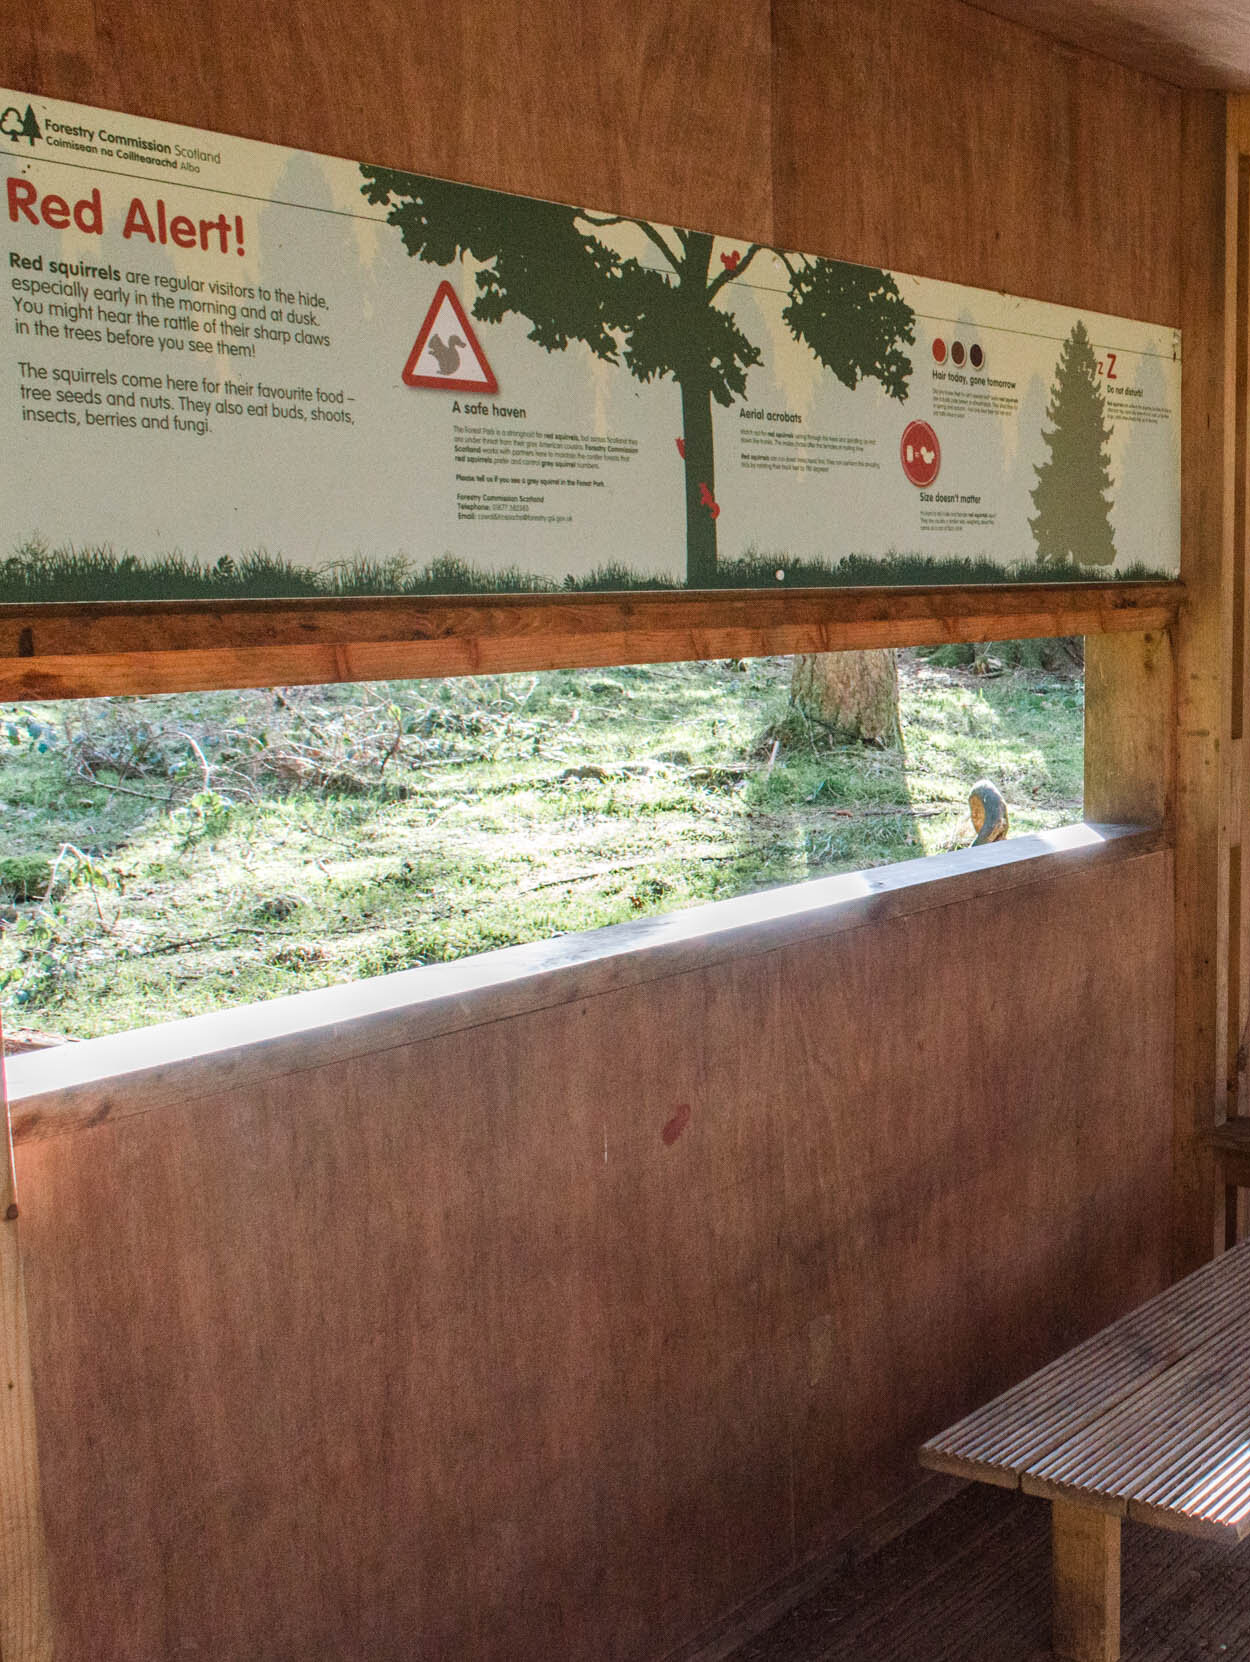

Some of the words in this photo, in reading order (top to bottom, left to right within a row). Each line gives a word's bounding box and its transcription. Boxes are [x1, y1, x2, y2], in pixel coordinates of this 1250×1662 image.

[45, 118, 95, 141] Forestry
[98, 129, 172, 154] Commission
[174, 145, 221, 164] Scotland
[100, 148, 113, 157] na
[180, 162, 201, 174] Alba
[6, 177, 103, 235] Red
[123, 198, 245, 257] Alert!
[9, 251, 43, 272] Red
[49, 261, 121, 281] squirrels
[125, 271, 150, 285] are
[154, 275, 205, 293] regular
[208, 280, 255, 299] visitors
[258, 286, 272, 301] to
[274, 288, 295, 304] the
[299, 290, 330, 310] hide,
[11, 277, 89, 302] especially
[93, 286, 130, 306] early
[134, 289, 148, 305] in
[151, 291, 175, 309] the
[178, 298, 237, 320] morning
[240, 305, 266, 320] and
[270, 309, 283, 322] at
[286, 309, 321, 327] dusk.
[12, 295, 43, 315] You
[49, 301, 94, 322] might
[97, 305, 132, 325] hear
[136, 310, 160, 328] the
[163, 314, 200, 332] rattle
[203, 319, 217, 333] of
[220, 319, 250, 338] their
[253, 324, 291, 344] sharp
[294, 329, 331, 347] claws
[14, 318, 30, 335] in
[34, 319, 60, 338] the
[63, 323, 103, 343] trees
[106, 327, 154, 348] before
[157, 337, 184, 352] you
[188, 339, 213, 353] see
[216, 339, 256, 358] them!
[17, 361, 48, 380] The
[52, 367, 118, 385] squirrels
[121, 374, 162, 389] come
[166, 374, 199, 392] here
[202, 377, 221, 394] for
[224, 380, 254, 397] their
[257, 382, 314, 402] favourite
[316, 387, 345, 404] food
[932, 369, 947, 381] Hair
[948, 372, 968, 385] today,
[970, 376, 986, 386] gone
[987, 377, 1017, 389] tomorrow
[1107, 384, 1115, 394] Do
[20, 384, 52, 401] tree
[56, 388, 103, 405] seeds
[106, 392, 136, 408] and
[140, 395, 175, 410] nuts.
[179, 396, 212, 415] They
[215, 399, 244, 416] also
[247, 403, 268, 417] eat
[271, 403, 308, 422] buds,
[311, 406, 356, 426] shoots,
[452, 400, 462, 414] A
[464, 402, 489, 416] safe
[492, 403, 527, 418] haven
[740, 408, 765, 420] Aerial
[767, 411, 803, 424] acrobats
[22, 405, 81, 427] insects,
[85, 410, 137, 428] berries
[141, 415, 169, 431] and
[173, 415, 214, 436] fungi.
[454, 445, 481, 453] Scotland
[454, 455, 466, 463] red
[466, 456, 493, 464] squirrels
[476, 474, 485, 482] tell
[499, 477, 510, 485] you
[527, 478, 539, 486] grey
[540, 479, 560, 487] squirrel
[576, 479, 592, 487] Forest
[457, 493, 481, 503] Forestry
[483, 494, 518, 502] Commission
[519, 495, 545, 504] Scotland
[920, 492, 934, 502] Size
[935, 493, 959, 503] doesn't
[960, 495, 981, 504] matter
